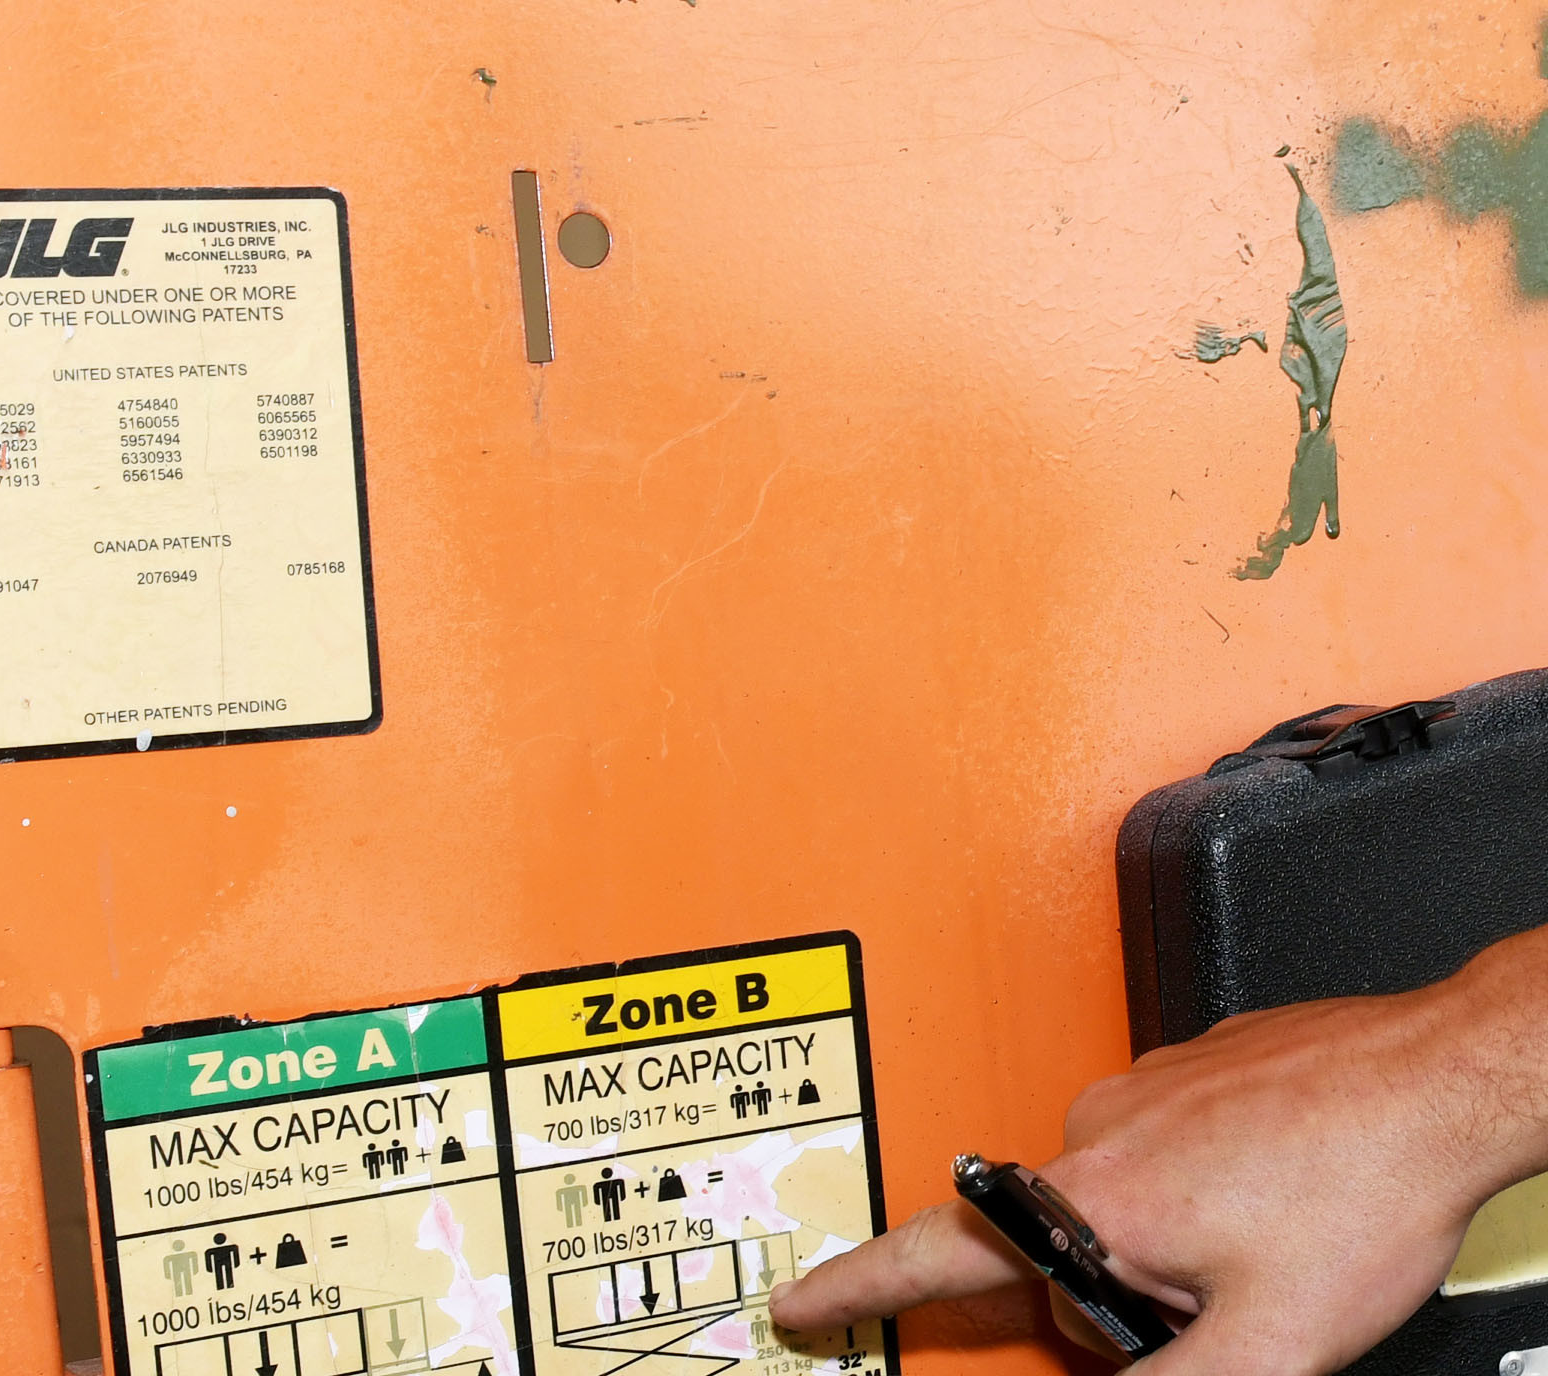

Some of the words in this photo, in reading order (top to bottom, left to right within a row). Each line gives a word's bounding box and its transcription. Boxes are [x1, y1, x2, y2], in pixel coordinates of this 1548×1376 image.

[161, 222, 188, 234] JLG
[192, 221, 280, 233] INDUSTRIES,
[284, 220, 311, 232] INC.
[201, 237, 206, 247] 1
[211, 236, 235, 247] JLG
[238, 236, 275, 247] DRIVE
[164, 249, 289, 261] McCONNELLSBURG,
[296, 249, 312, 259] PA
[223, 264, 257, 274] 17233
[91, 288, 158, 304] UNDER
[163, 287, 204, 303] ONE
[209, 286, 237, 302] OR
[242, 285, 297, 300] MORE
[8, 312, 33, 327] OF
[39, 311, 78, 327] THE
[84, 308, 196, 325] FOLLOWING
[202, 306, 284, 322] PATENTS
[52, 367, 111, 382] UNITED
[116, 365, 174, 380] STATES
[179, 363, 248, 377] PATENTS
[117, 397, 178, 411] 4754840
[256, 392, 314, 407] 5740887
[119, 415, 180, 430] 5160055
[257, 410, 316, 424] 6065565
[120, 433, 180, 447] 5957494
[259, 427, 318, 442] 6390312
[121, 450, 182, 465] 6330933
[259, 444, 318, 459] 6501198
[122, 467, 183, 482] 6561546
[93, 538, 159, 554] CANADA
[162, 534, 232, 550] PATENTS
[287, 560, 345, 576] 0785168
[136, 569, 197, 585] 2076949
[83, 709, 139, 726] OTHER
[143, 703, 212, 721] PATENTS
[217, 698, 287, 715] PENDING
[583, 988, 718, 1036] Zone
[734, 972, 769, 1013] B
[187, 1048, 338, 1097] Zone
[354, 1027, 396, 1072] A
[543, 1061, 627, 1106] MAX
[637, 1032, 815, 1091] CAPACITY
[149, 1121, 241, 1169] MAX
[253, 1088, 450, 1152] CAPACITY
[543, 1118, 583, 1143] 700
[590, 1105, 667, 1135] lbs/317
[144, 1180, 200, 1208] 1000
[208, 1165, 293, 1199] lbs/454
[542, 1236, 586, 1263] 700
[593, 1219, 677, 1255] lbs/317
[685, 1216, 717, 1249] kg
[138, 1306, 200, 1337] 1000
[207, 1288, 301, 1325] lbs/454
[310, 1283, 341, 1310] kg
